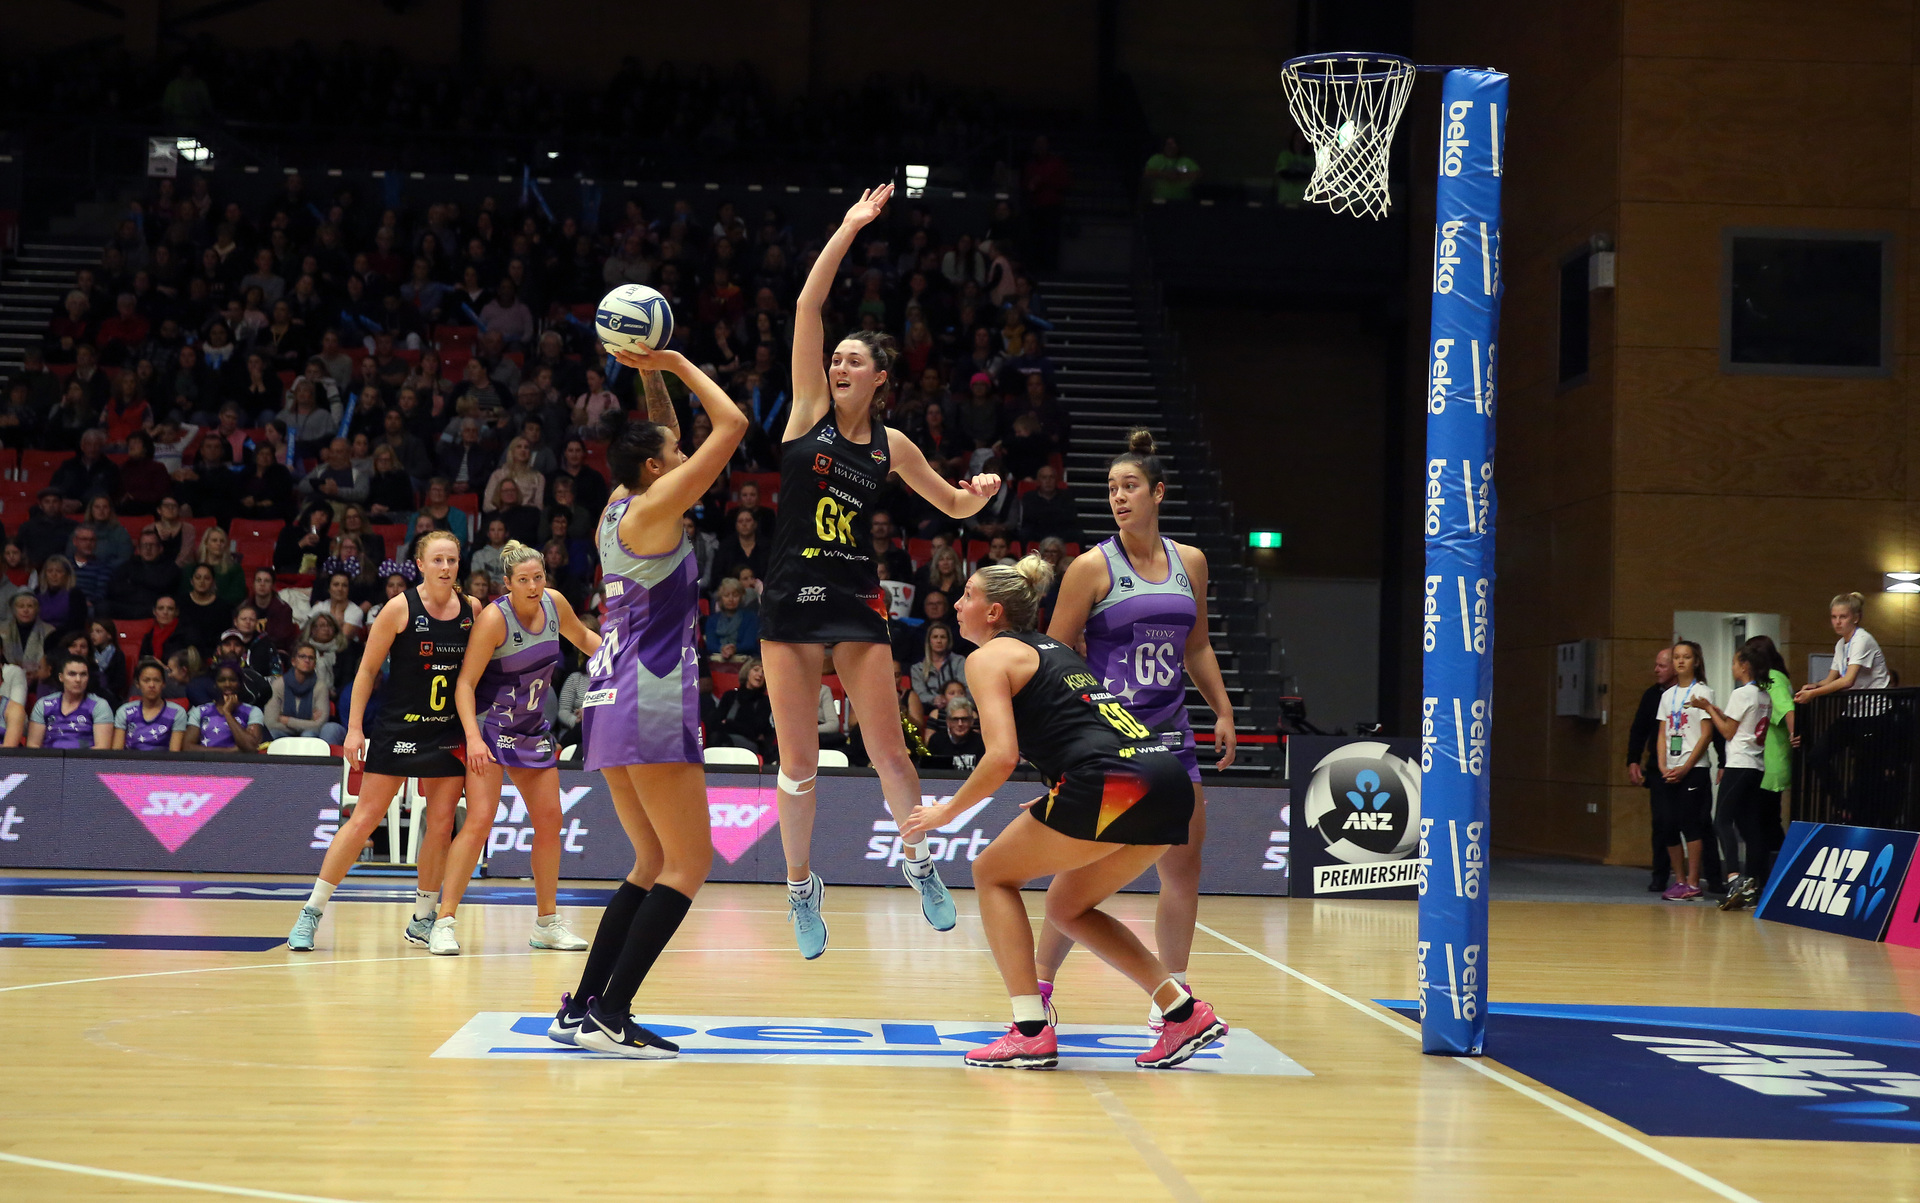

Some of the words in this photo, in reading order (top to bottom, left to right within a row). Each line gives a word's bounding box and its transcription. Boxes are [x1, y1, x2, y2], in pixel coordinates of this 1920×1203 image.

[1444, 100, 1474, 177] beko
[1437, 220, 1463, 295] beko
[1430, 338, 1455, 415] beko
[828, 486, 863, 508] SUZUKI
[834, 467, 877, 490] WAIKATO
[1426, 458, 1447, 536] beko
[816, 497, 857, 547] GK
[796, 593, 827, 603] sport
[1423, 575, 1442, 653] beko
[430, 674, 448, 711] C
[526, 678, 544, 711] C
[1135, 642, 1175, 687] GS
[496, 742, 516, 750] sport
[1421, 697, 1438, 773] beko
[1469, 699, 1486, 776] beko
[141, 791, 214, 817] SKY
[1341, 812, 1393, 831] ANZ
[1418, 818, 1434, 896] beko
[1464, 821, 1484, 900] beko
[1786, 846, 1870, 917] ANZ
[1417, 941, 1431, 1020] beko
[1463, 944, 1480, 1021] beko
